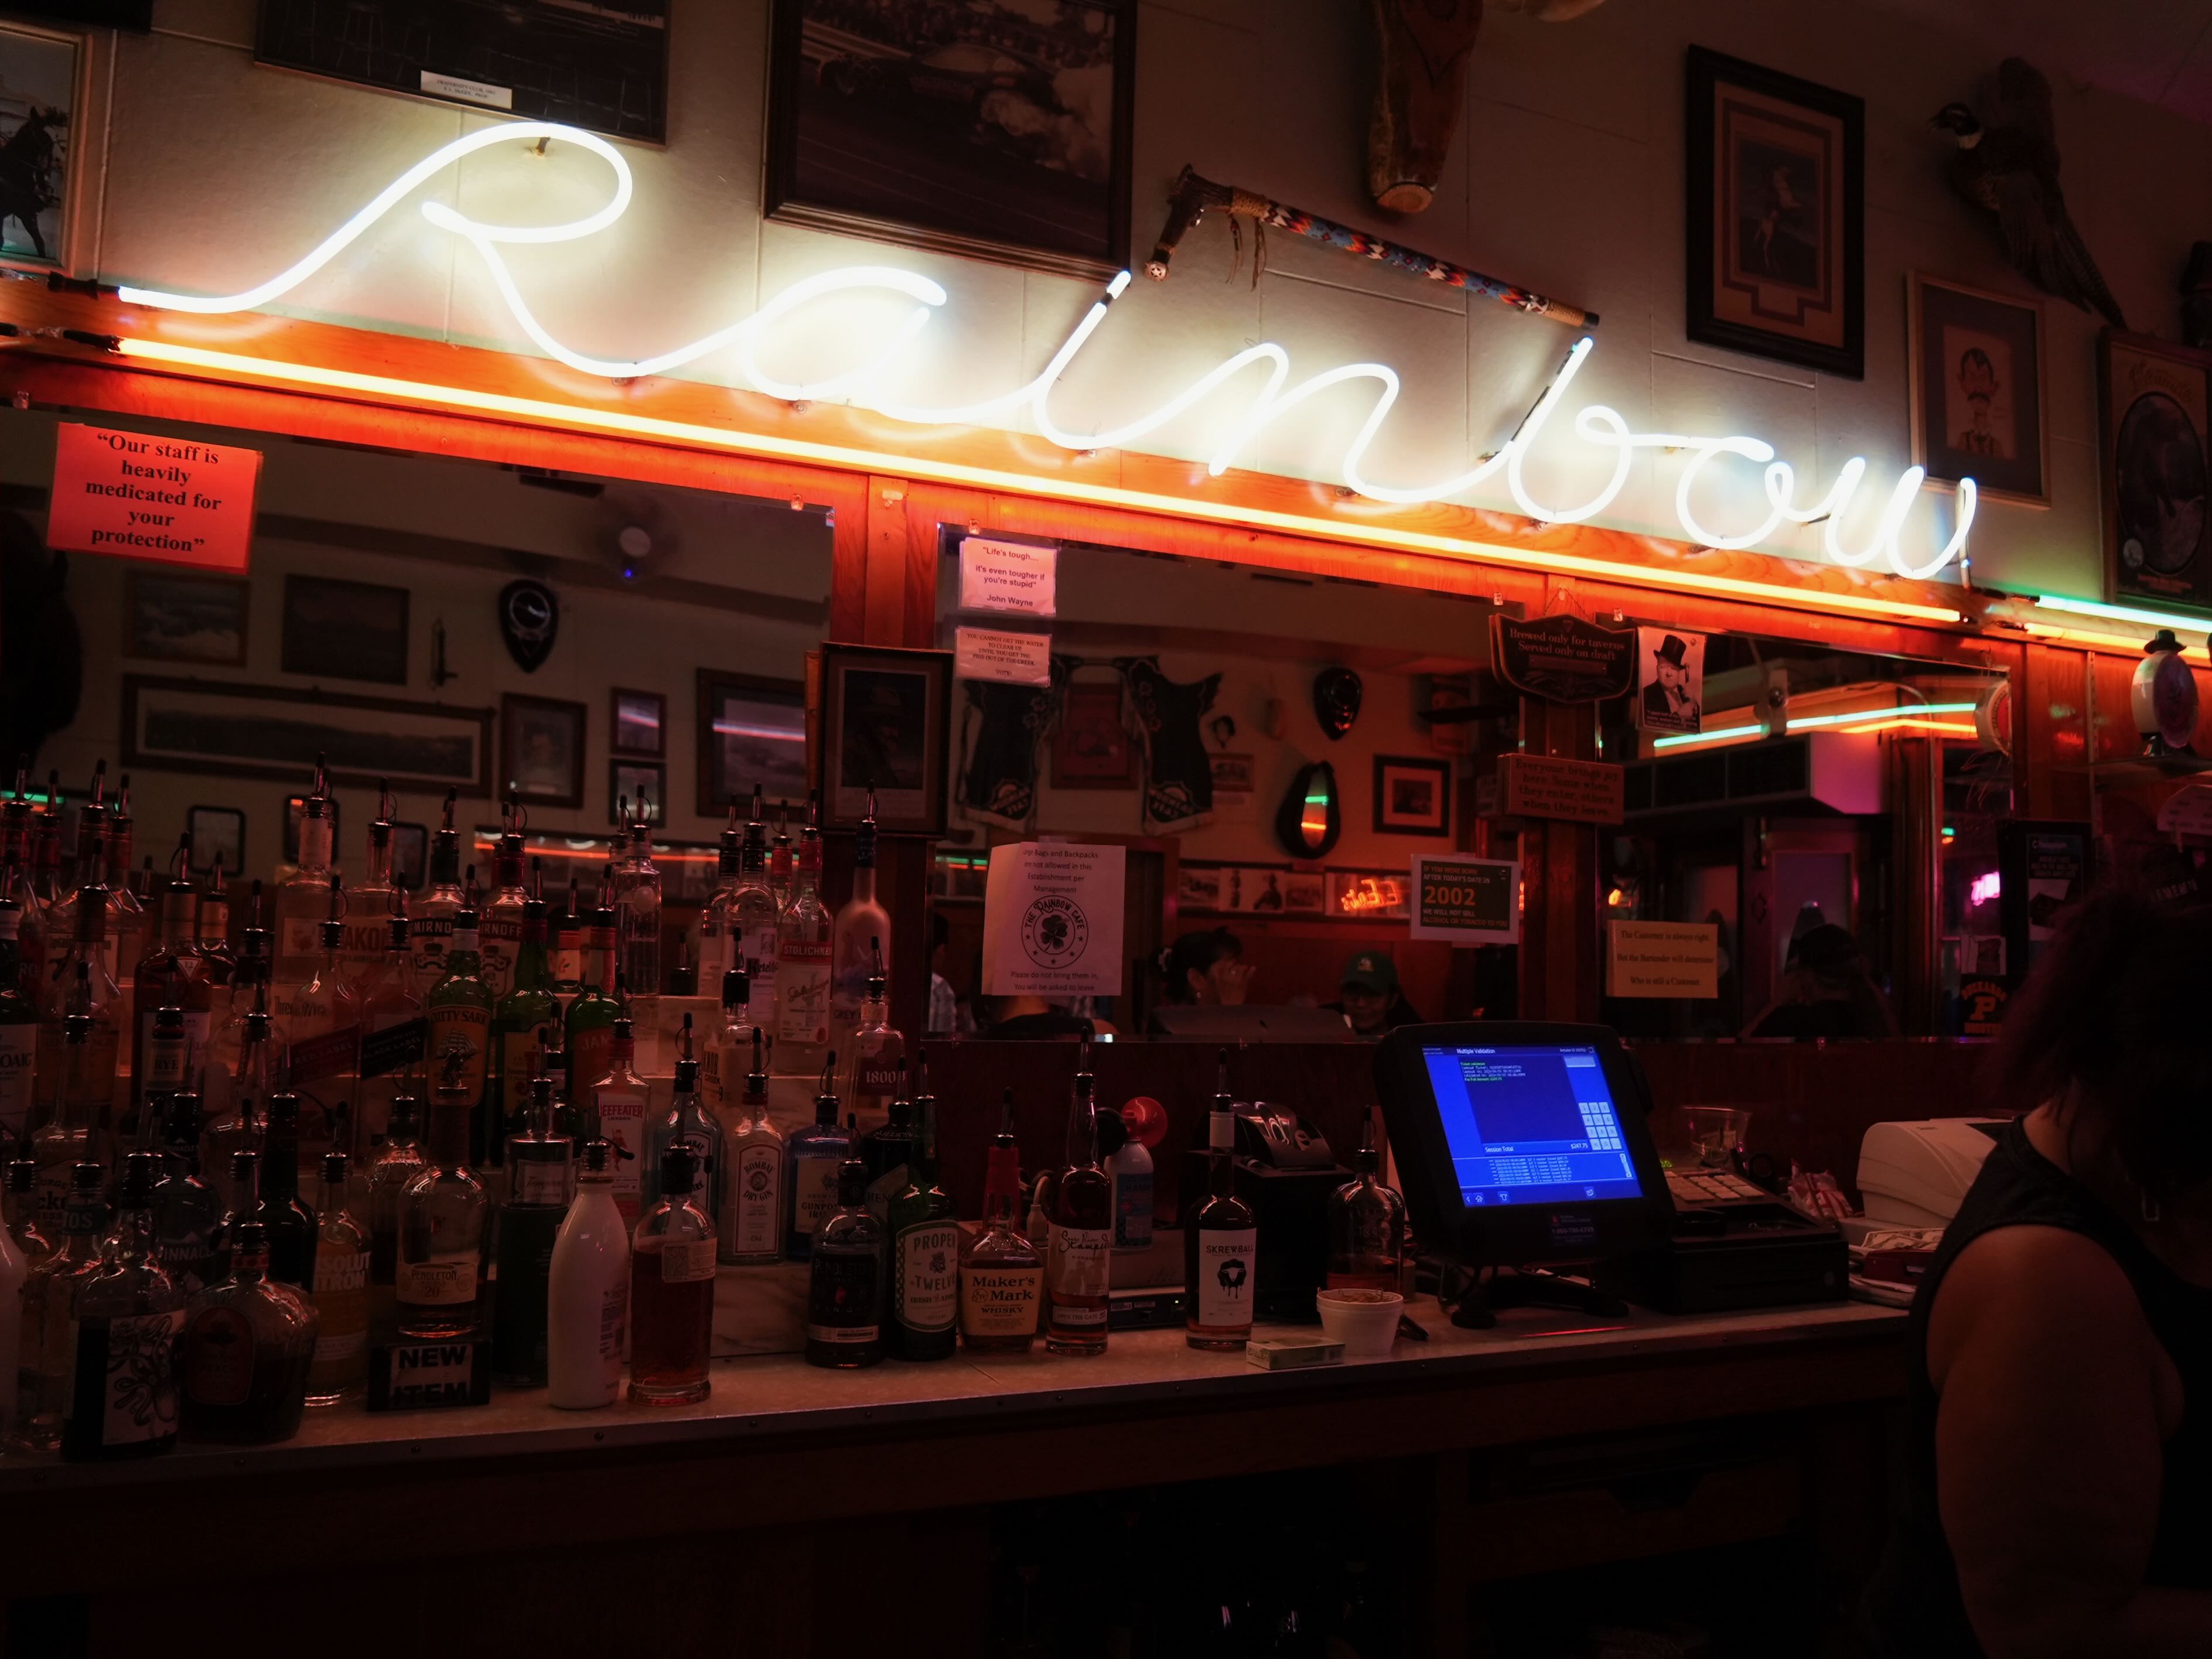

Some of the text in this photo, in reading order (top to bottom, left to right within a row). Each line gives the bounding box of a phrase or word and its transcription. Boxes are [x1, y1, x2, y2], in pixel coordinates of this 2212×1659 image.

[119, 122, 1977, 580] Rainbow
[155, 444, 201, 461] staff
[205, 449, 219, 464] is
[122, 460, 192, 486] heavily
[86, 482, 221, 510] medicated for
[128, 511, 175, 527] your
[984, 576, 1008, 585] you're
[1009, 569, 1038, 580] tougher
[986, 595, 1033, 607] John Wayne
[1510, 628, 1626, 651] Brewed only for taverns
[1518, 640, 1552, 654] Served
[1554, 646, 1574, 657] only
[1591, 650, 1617, 661] draft
[1516, 759, 1564, 773] Everyone
[1568, 766, 1600, 780] brings
[1554, 776, 1579, 788] Some
[1583, 781, 1609, 791] when
[1519, 784, 1542, 798] they
[1581, 793, 1614, 804] others
[1523, 800, 1550, 811] when
[1554, 803, 1577, 815] they
[1064, 851, 1098, 859] Backpacks
[1034, 885, 1077, 893] Management
[1425, 885, 1476, 906] 2002
[1025, 899, 1084, 930] THE RAINBOW CAFE
[411, 921, 452, 933] MIRNO
[479, 923, 523, 936] IRNOFF
[1672, 933, 1692, 941] always
[1685, 955, 1715, 964] determine
[1630, 977, 1644, 985] Who
[1969, 996, 1996, 1020] P
[295, 1041, 353, 1064] RED LABEL
[154, 1059, 178, 1069] RYE
[866, 1070, 896, 1083] 1800
[744, 1161, 774, 1175] BOMBAY
[743, 1189, 773, 1201] DRY GIN
[914, 1233, 956, 1251] PROPER
[1206, 1244, 1253, 1253] SKREWBALL
[412, 1269, 457, 1281] PENDLETON
[972, 1276, 1035, 1286] Maker's
[425, 1286, 439, 1298] 20
[991, 1289, 1033, 1300] Mark
[399, 1347, 466, 1368] NEW
[394, 1383, 466, 1405] ITEM
